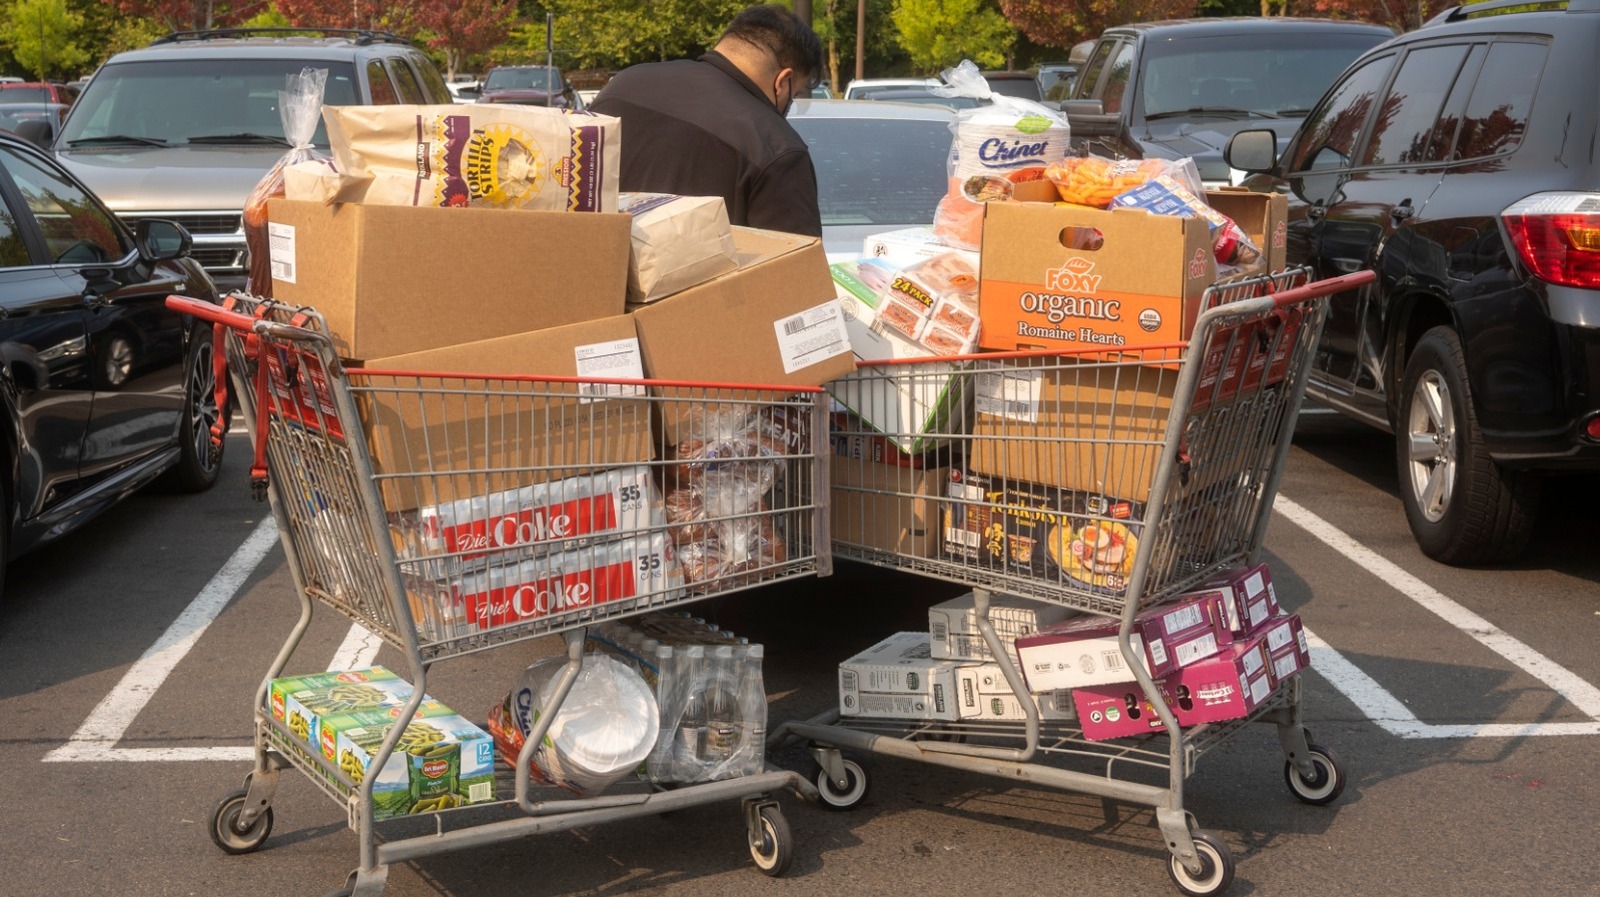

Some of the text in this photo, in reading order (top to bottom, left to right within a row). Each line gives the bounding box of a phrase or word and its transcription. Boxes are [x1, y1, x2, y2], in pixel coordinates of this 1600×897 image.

[978, 137, 1049, 161] Chinet
[467, 129, 486, 202] TORTILLA
[480, 138, 494, 195] STRIPS
[891, 278, 933, 308] 24 PACK
[1046, 268, 1102, 294] FOXY
[1020, 292, 1120, 323] organic
[1017, 321, 1125, 346] Romaine Hearts
[619, 485, 640, 502] 35
[622, 502, 642, 512] CANS
[458, 512, 571, 552] Diet Coke
[639, 553, 660, 571] 35
[641, 571, 661, 581] CANS
[475, 580, 590, 619] Diet Coke
[479, 743, 491, 755] 12
